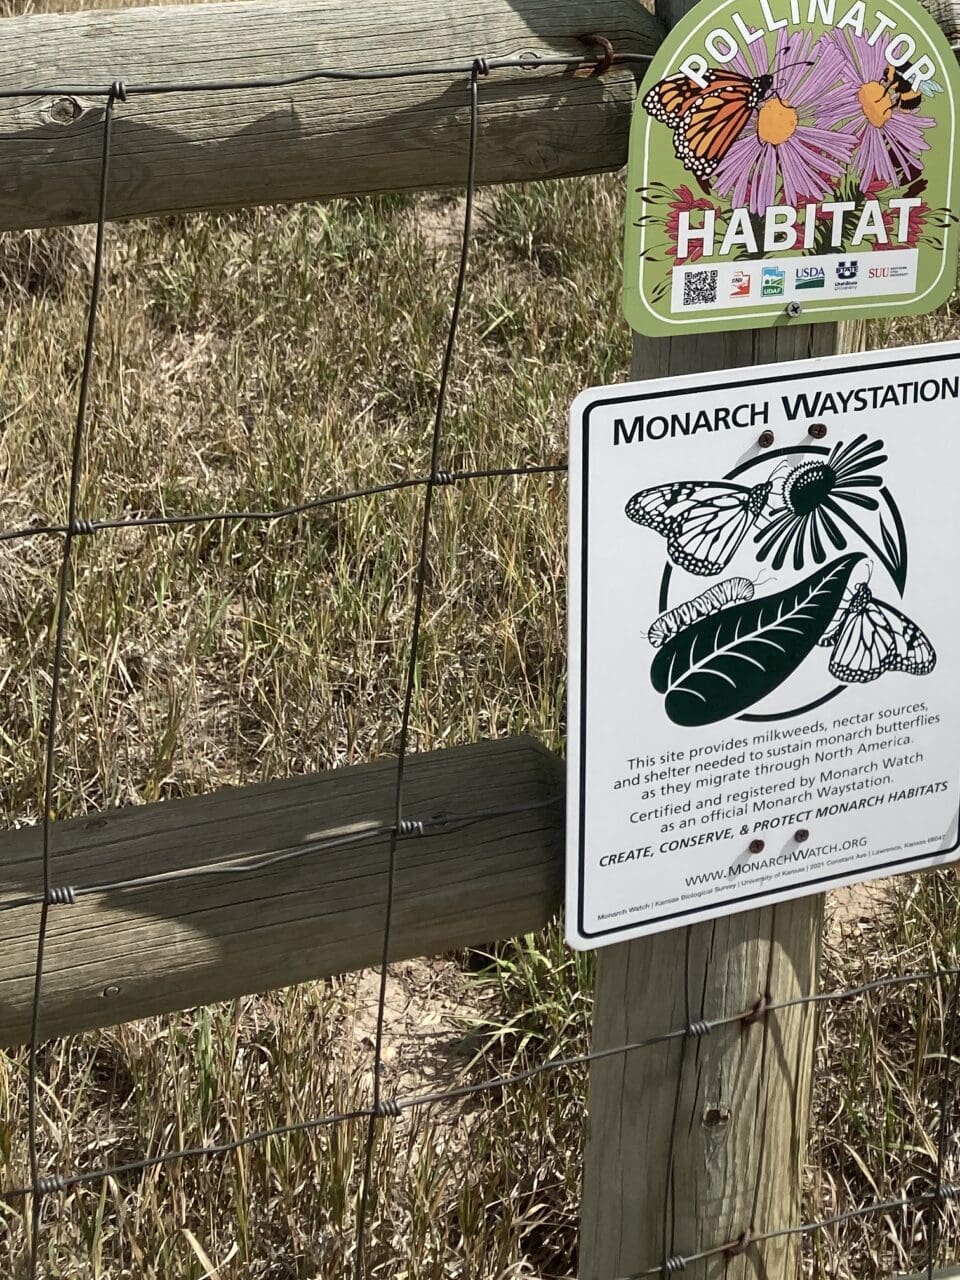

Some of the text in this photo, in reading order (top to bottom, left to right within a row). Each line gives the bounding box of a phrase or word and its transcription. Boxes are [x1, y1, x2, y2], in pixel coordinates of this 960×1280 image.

[677, 197, 922, 259] HABITAT
[795, 266, 825, 278] USDA
[868, 267, 889, 279] SUU
[613, 375, 960, 445] MONARCH WAYSTATION
[613, 713, 940, 789] and shelter needed to sustain monarch butterflies
[627, 702, 928, 771] This site provides milkweeds, nectar sources,
[641, 735, 914, 799] as they migrate through North America.
[629, 752, 923, 823] Certified and registered by Monarch Watch
[660, 775, 894, 833] as an official Monarch Waystation.
[599, 781, 948, 867] CREATE, CONSERVE, & PROTECT MONARCH HABITATS
[597, 910, 627, 920] Monarch
[629, 904, 650, 913] Watch
[655, 897, 679, 907] Kansas
[681, 888, 713, 900] Biological
[714, 884, 737, 893] Survey
[741, 874, 773, 886] University
[782, 867, 805, 876] Kansas
[826, 855, 855, 866] Constant
[856, 852, 867, 860] Ave
[872, 846, 903, 856] Lawrence,
[904, 839, 926, 848] Kansas
